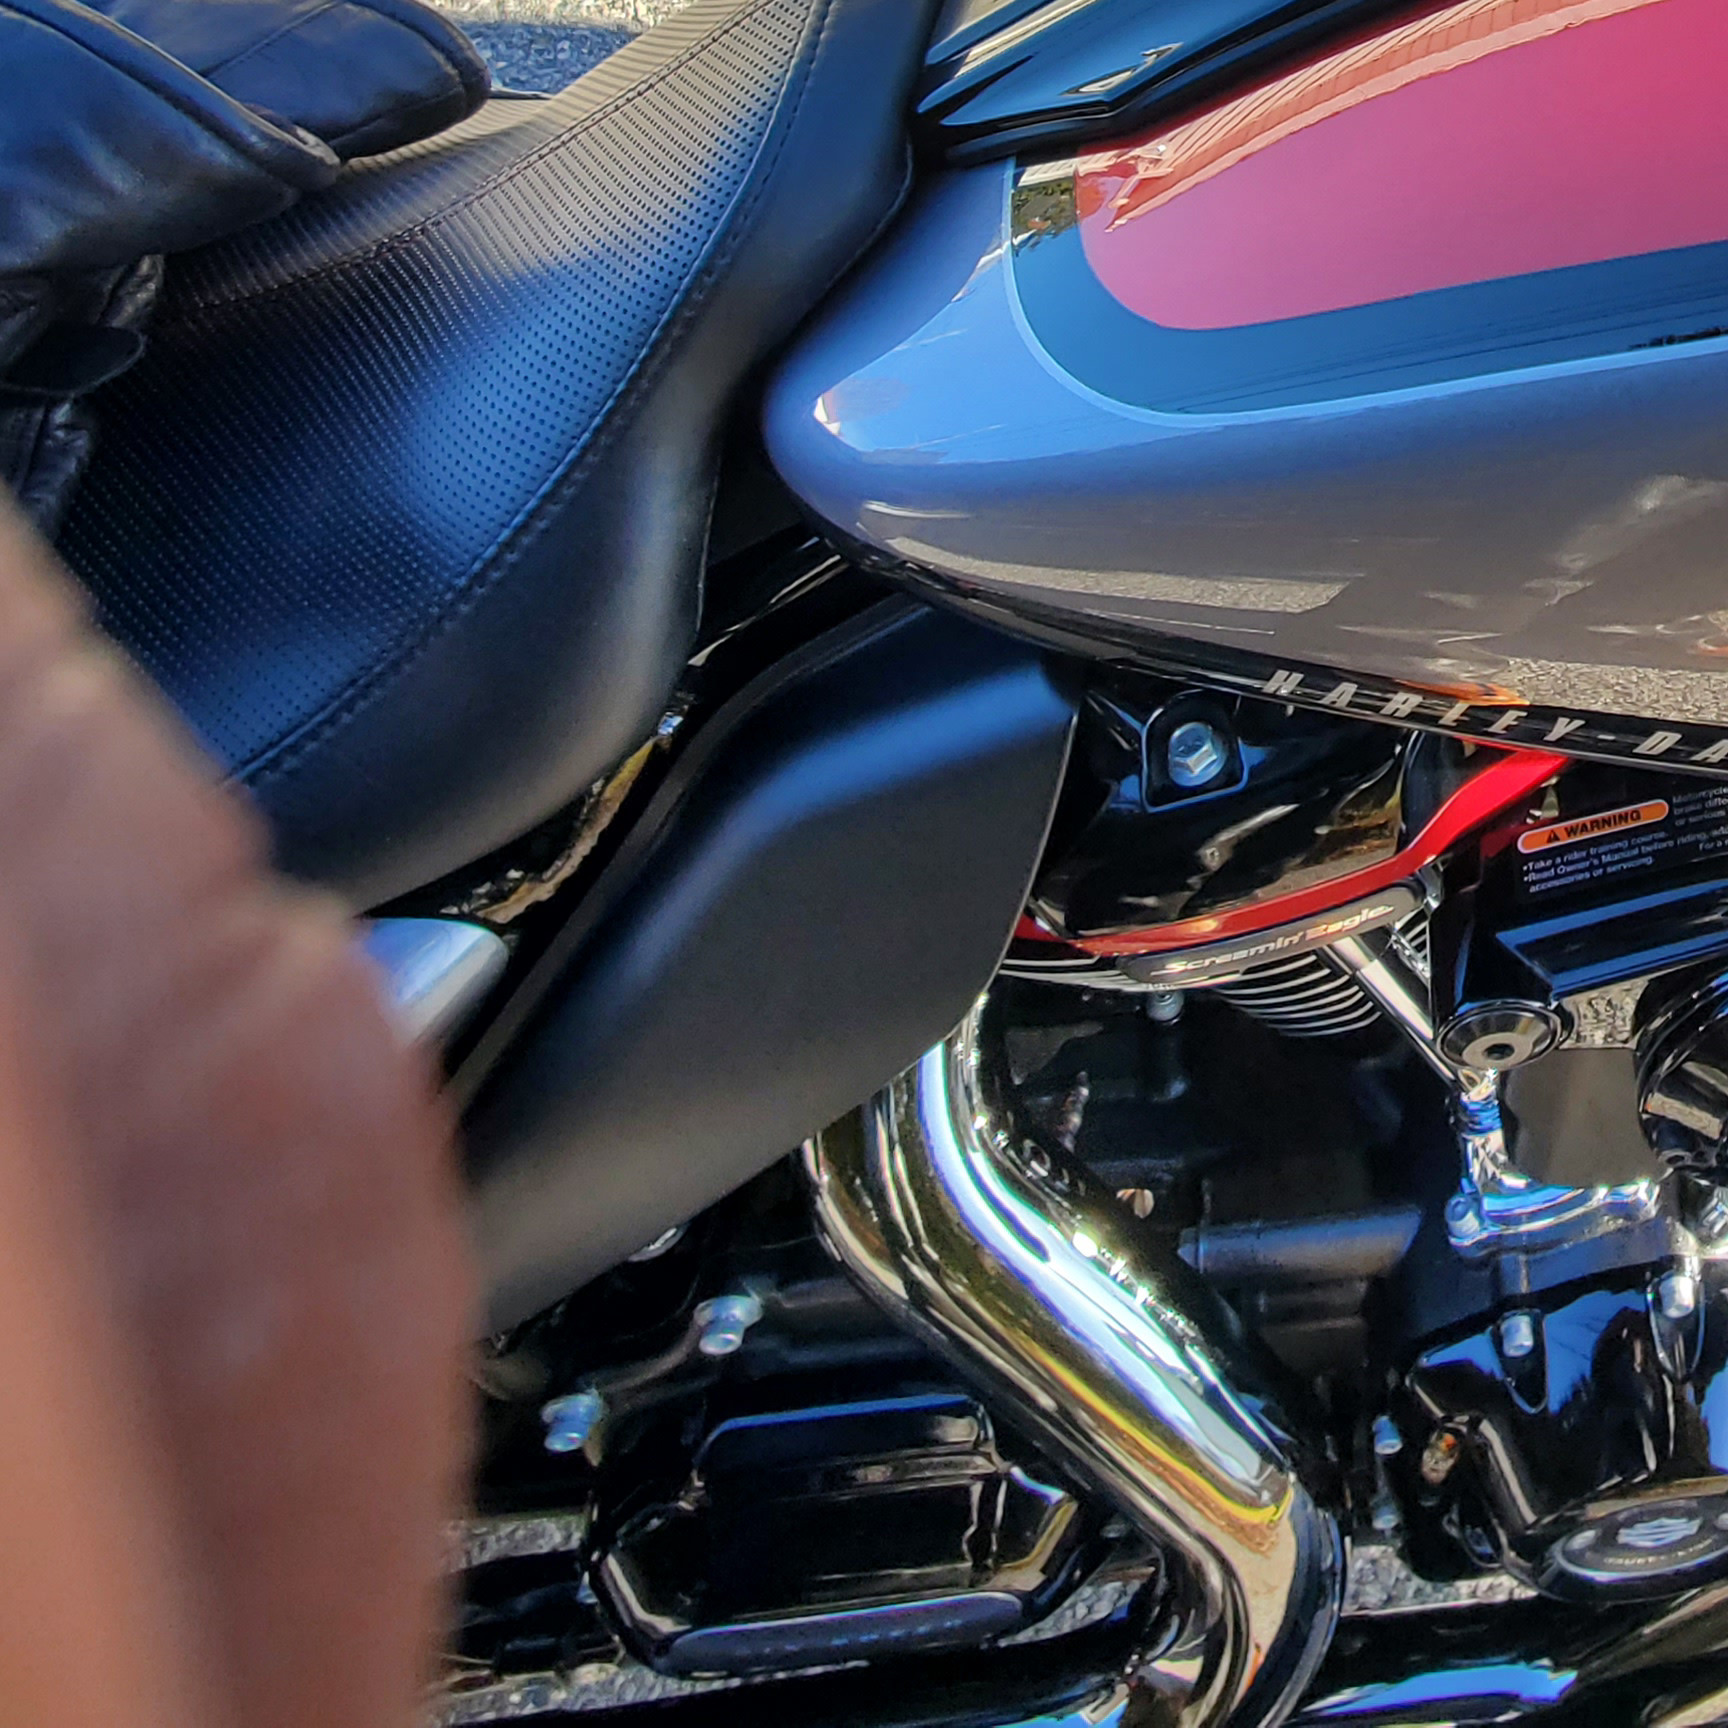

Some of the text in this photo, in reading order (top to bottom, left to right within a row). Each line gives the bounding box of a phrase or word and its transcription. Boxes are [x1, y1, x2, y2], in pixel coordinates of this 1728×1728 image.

[1564, 809, 1642, 837] WARNING
[1150, 904, 1395, 976] Screamin' Eagle
